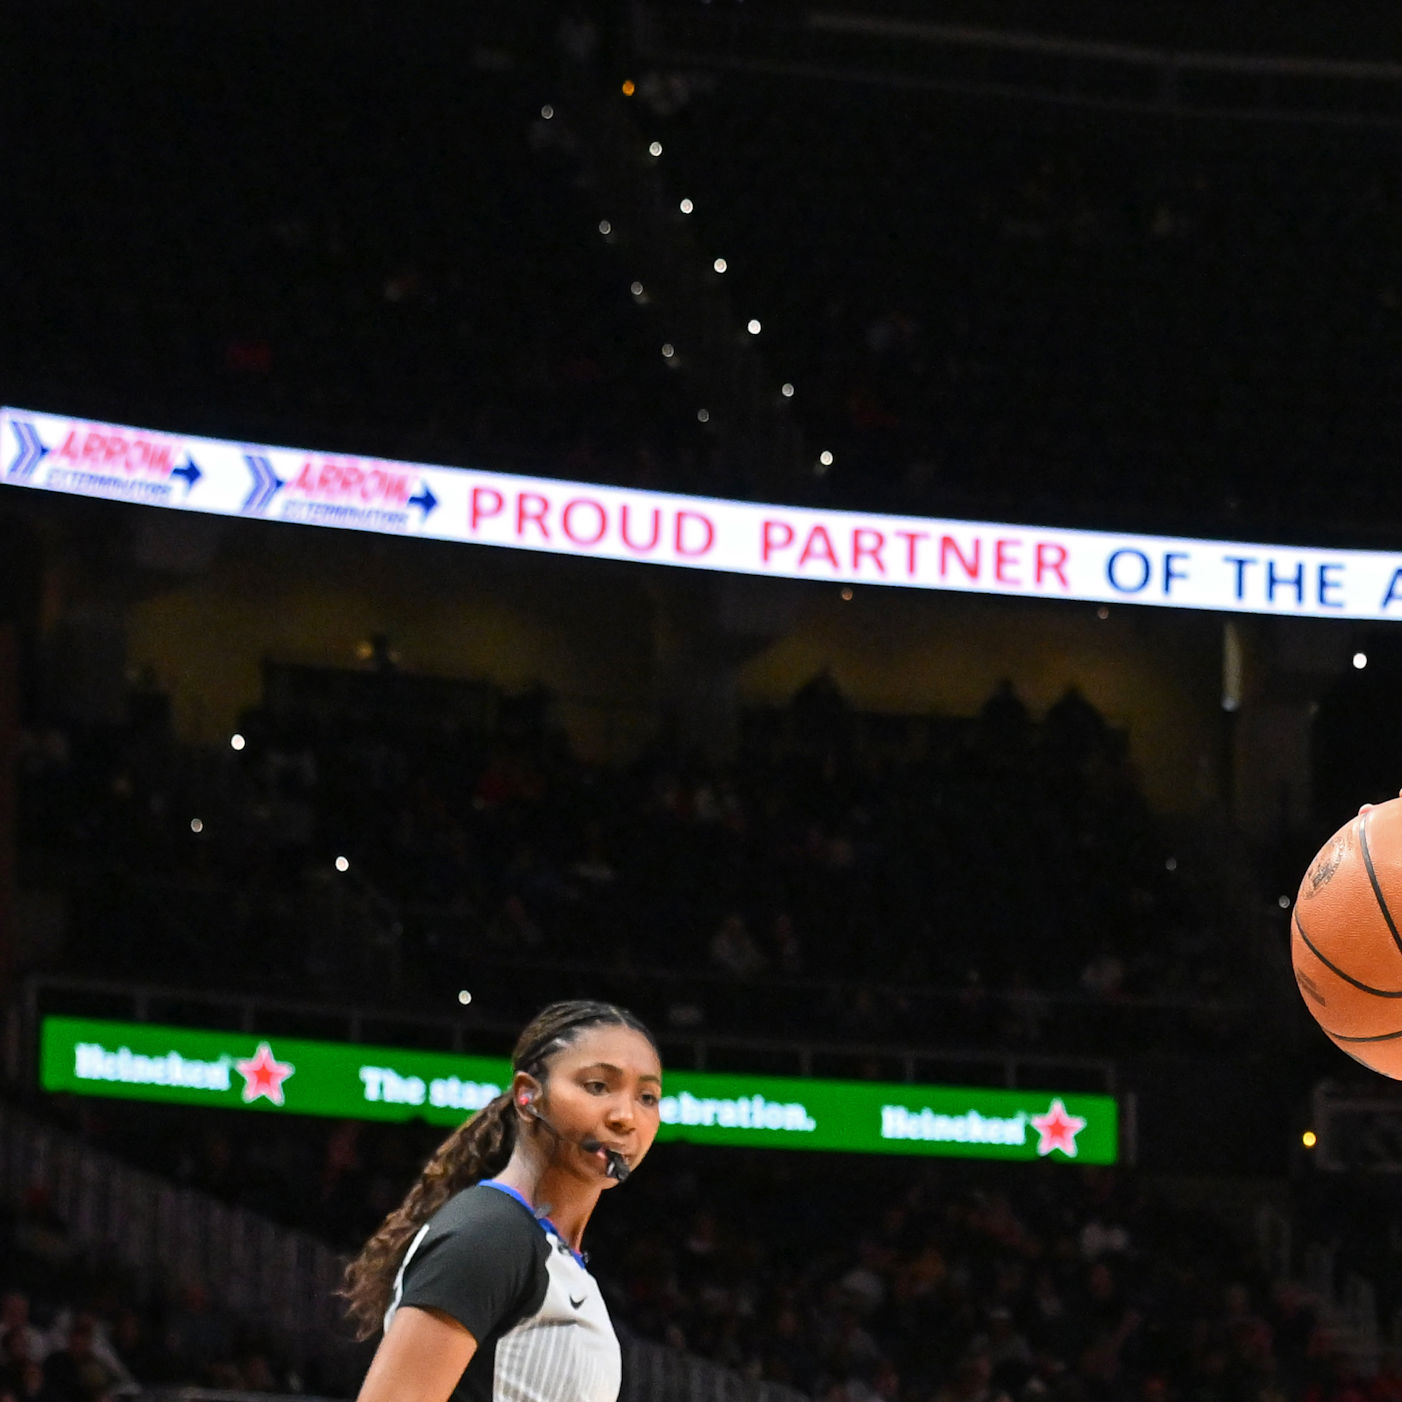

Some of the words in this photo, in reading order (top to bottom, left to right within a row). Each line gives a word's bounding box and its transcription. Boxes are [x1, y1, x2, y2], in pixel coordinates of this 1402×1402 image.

[469, 487, 714, 557] PROUD
[760, 520, 1068, 588] PARTNER
[1106, 546, 1192, 596] OF
[1224, 556, 1345, 608] THE
[75, 1042, 229, 1091] Heineken
[360, 1066, 425, 1105] The
[659, 1092, 816, 1131] ebration.
[881, 1104, 1026, 1145] Heineken
